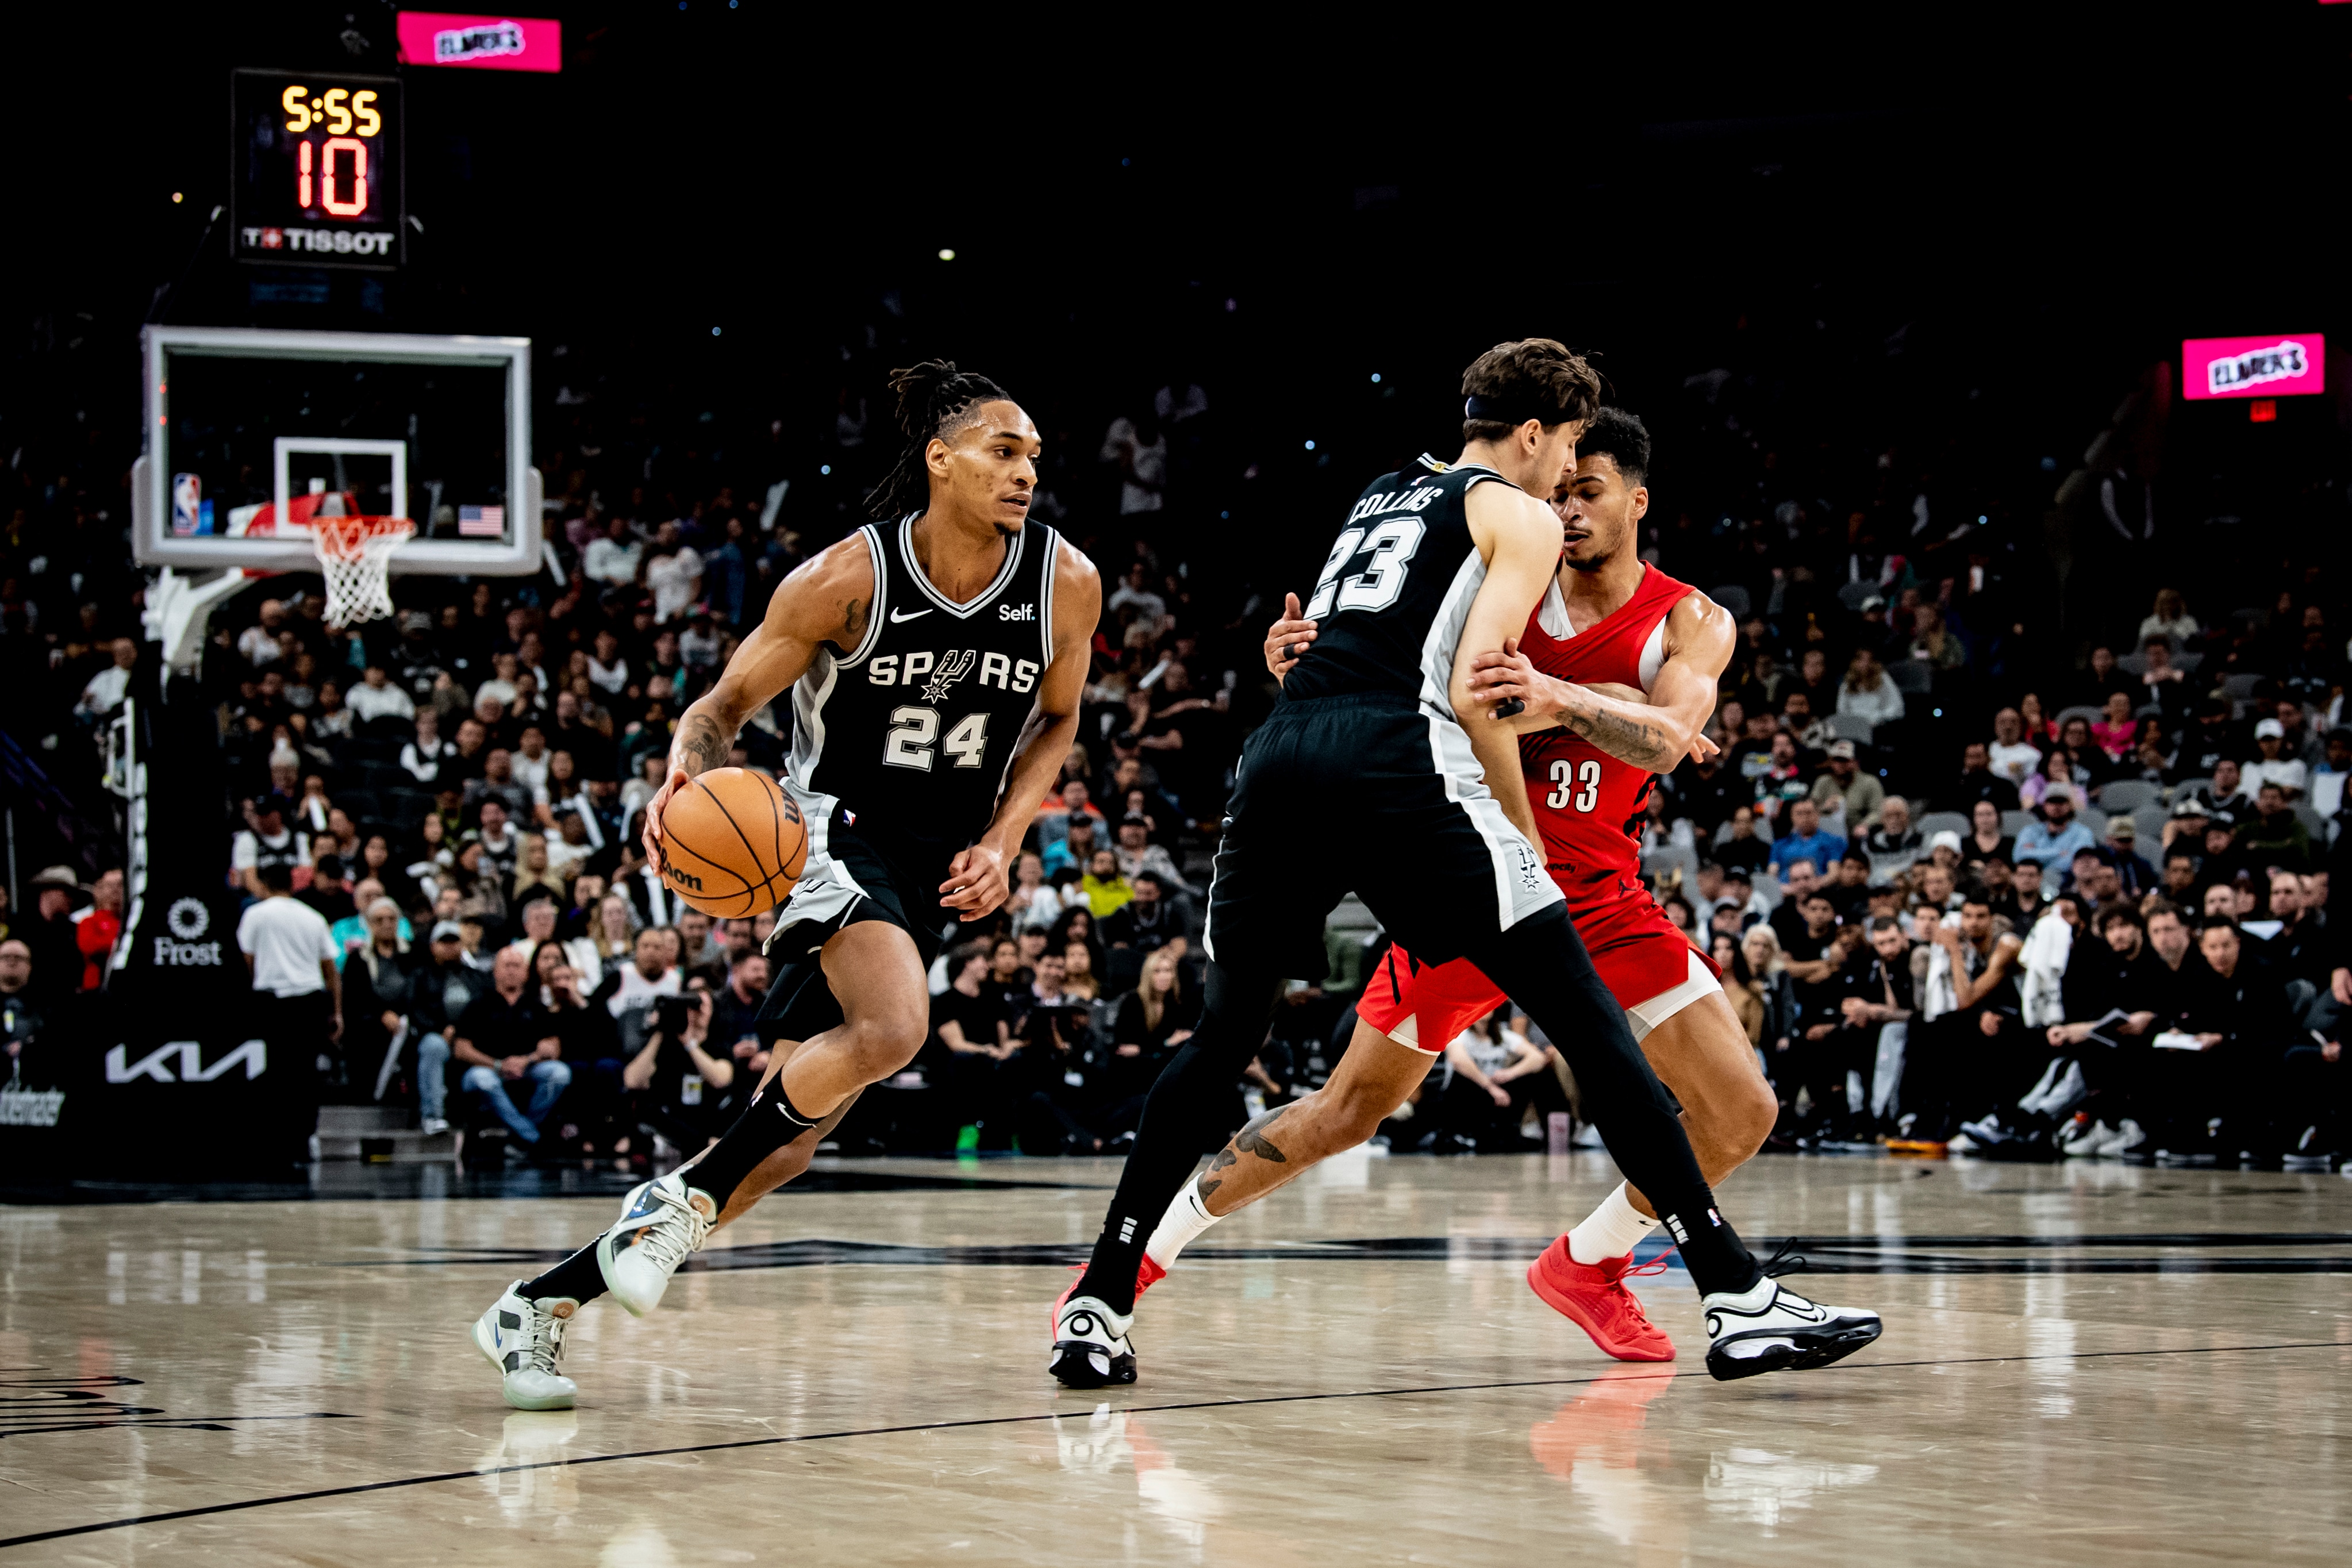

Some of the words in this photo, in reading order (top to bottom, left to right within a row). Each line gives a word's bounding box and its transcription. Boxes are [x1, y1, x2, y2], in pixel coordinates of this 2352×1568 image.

[282, 86, 381, 137] 5:55
[299, 137, 367, 216] 10
[283, 227, 395, 255] TISSOT
[1347, 486, 1444, 525] COLLINS
[1303, 516, 1427, 621] 23
[868, 650, 1039, 702] SPURS
[882, 705, 990, 772] 24
[1546, 759, 1601, 813] 33
[659, 842, 704, 893] lson
[153, 936, 222, 966] Frost
